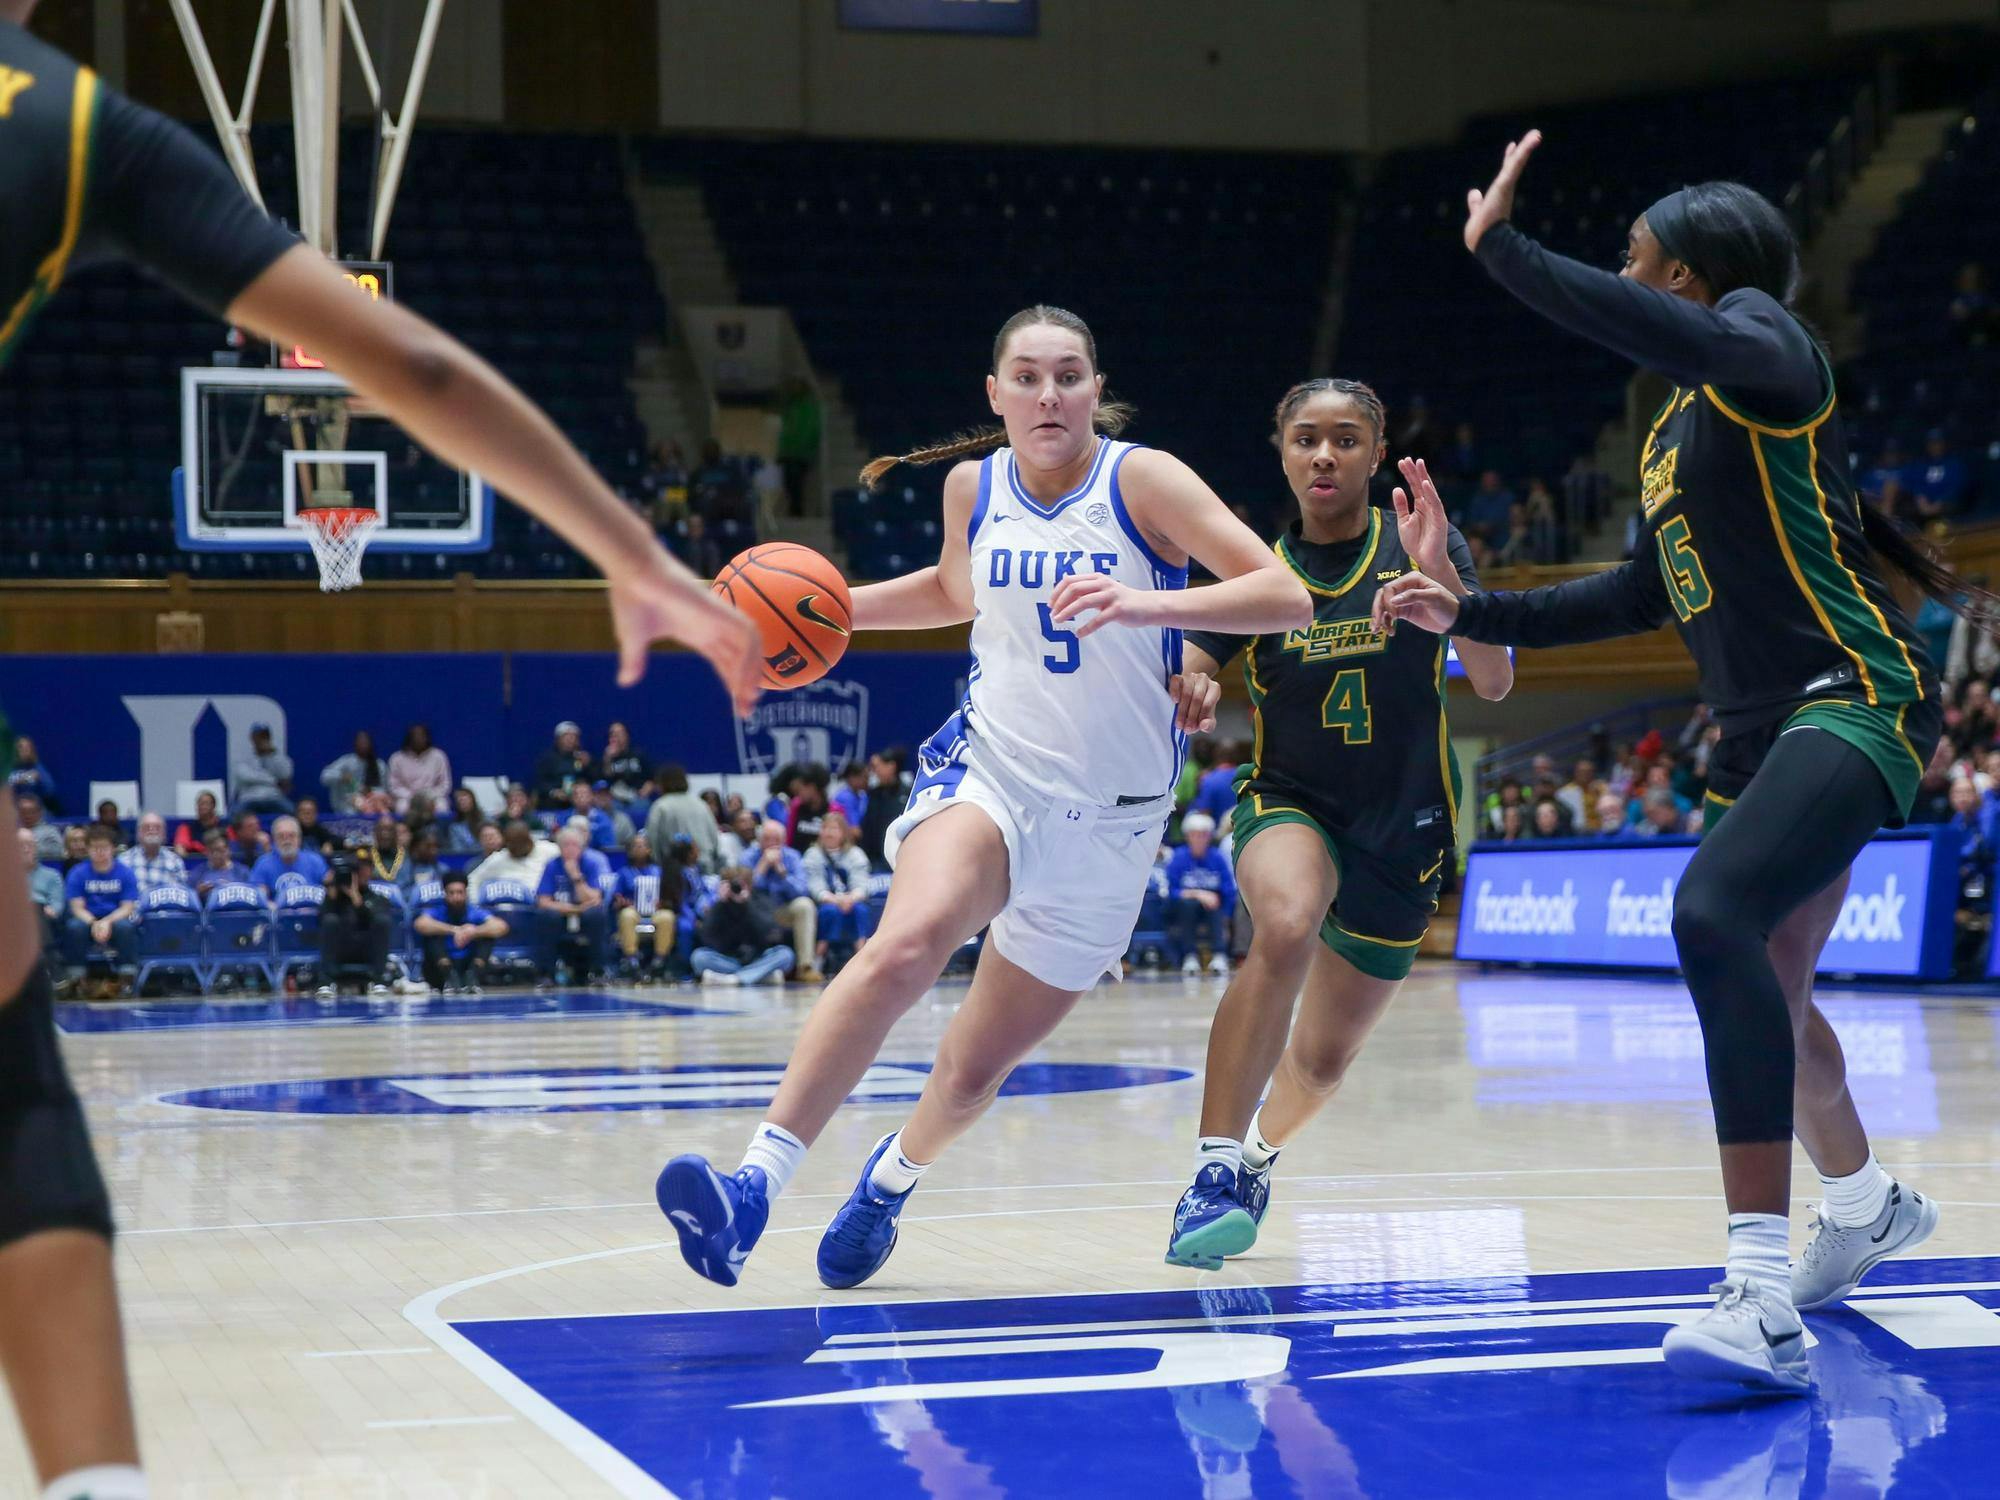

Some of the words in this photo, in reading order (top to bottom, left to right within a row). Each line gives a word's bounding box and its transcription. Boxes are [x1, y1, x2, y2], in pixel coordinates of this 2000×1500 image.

[989, 548, 1118, 588] DUKE
[1656, 514, 1713, 623] 15
[1036, 602, 1080, 673] 5
[1288, 620, 1375, 645] NORFOL
[1307, 631, 1383, 657] STATE
[1322, 668, 1371, 744] 4
[1475, 879, 1578, 934] facebook
